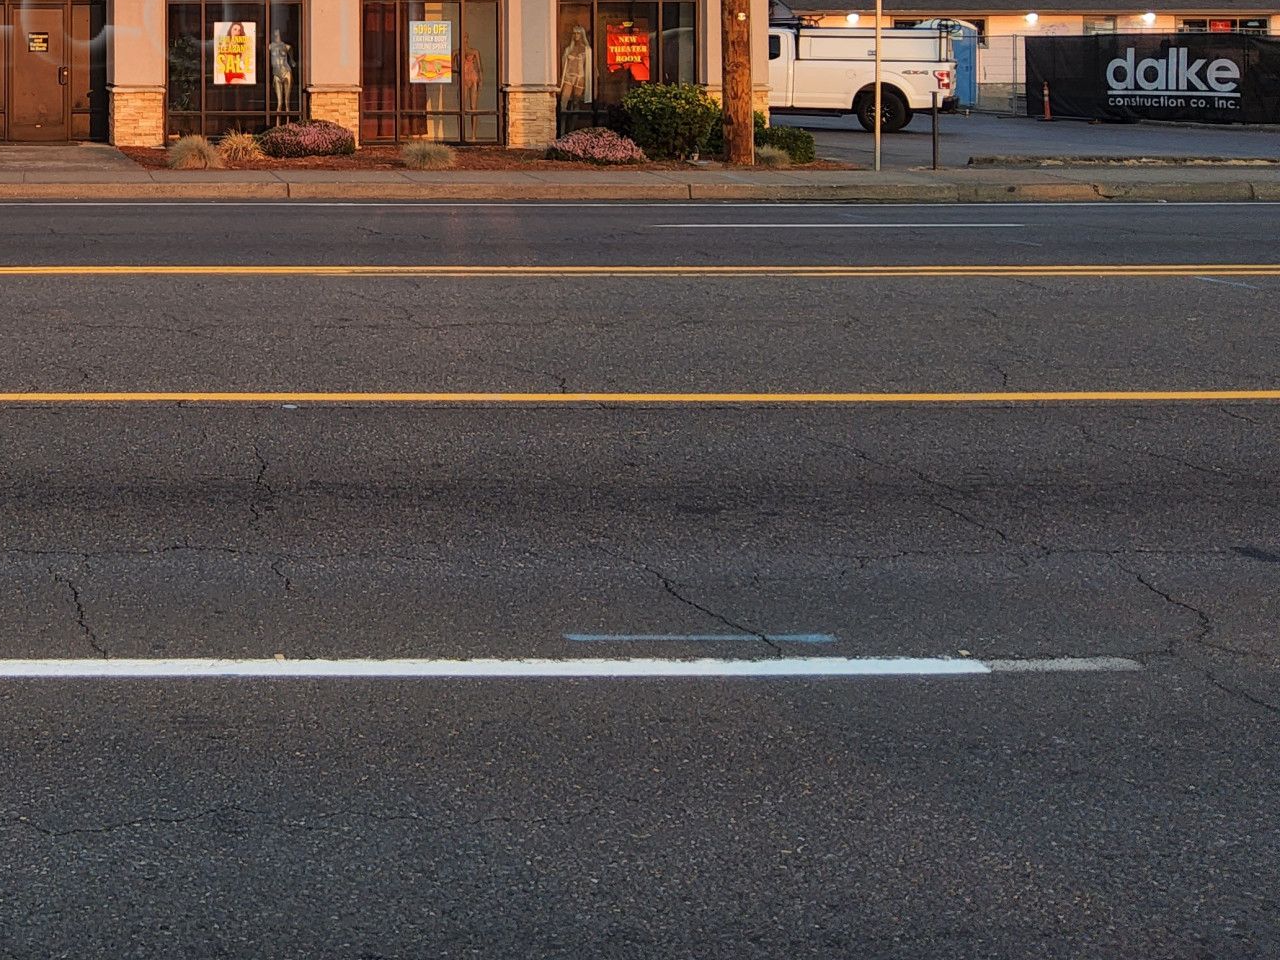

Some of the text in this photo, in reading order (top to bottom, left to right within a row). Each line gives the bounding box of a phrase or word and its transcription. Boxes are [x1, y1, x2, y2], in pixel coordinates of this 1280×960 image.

[433, 24, 448, 35] OFF
[618, 35, 638, 43] NEW
[609, 45, 647, 53] THEATER
[216, 54, 254, 74] SALE
[615, 55, 642, 63] ROOM
[1106, 47, 1241, 92] dalke
[1108, 96, 1241, 109] construction co. inc.
